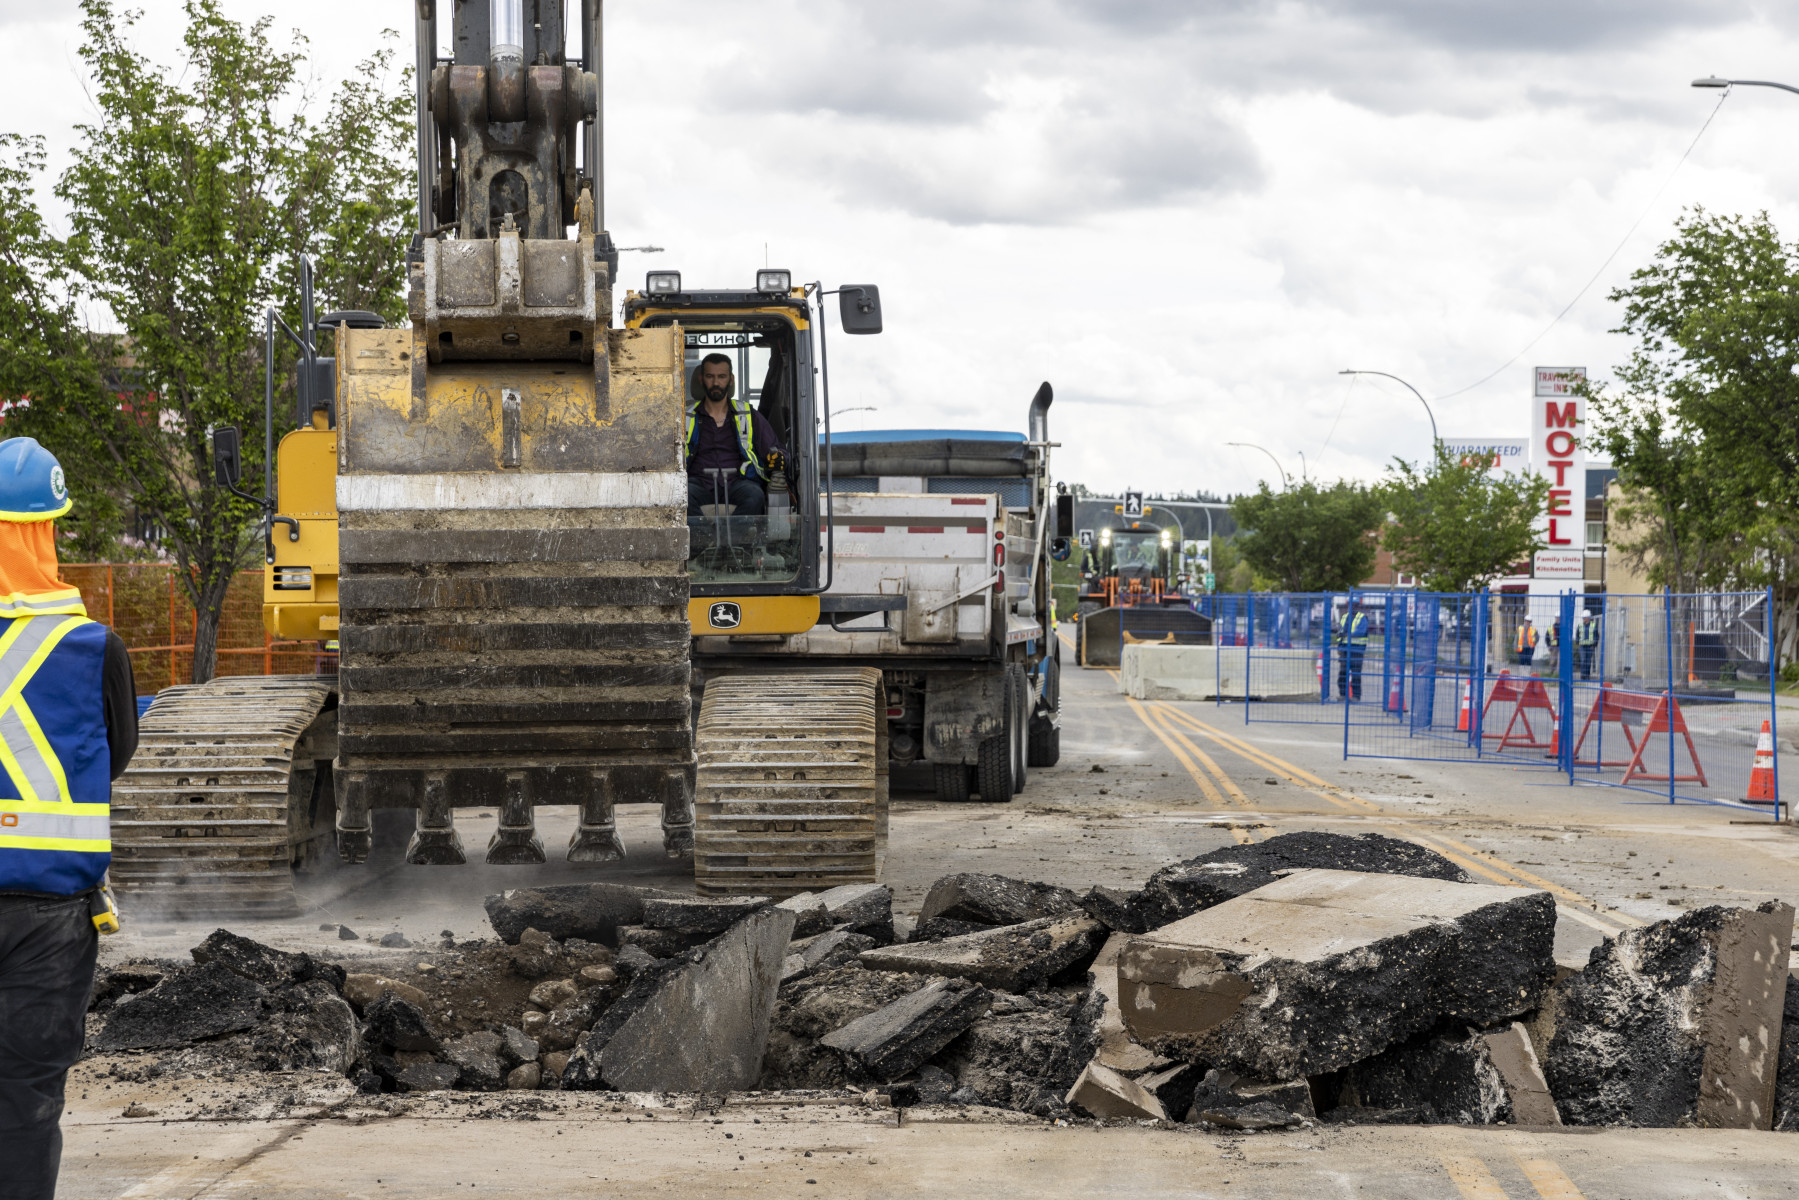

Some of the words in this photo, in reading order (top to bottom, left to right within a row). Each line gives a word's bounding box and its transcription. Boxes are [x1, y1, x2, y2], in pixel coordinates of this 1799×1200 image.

[1443, 444, 1522, 457] GUARANTEED!
[1545, 401, 1577, 545] MOTEL
[1536, 565, 1582, 573] Kitchenettes
